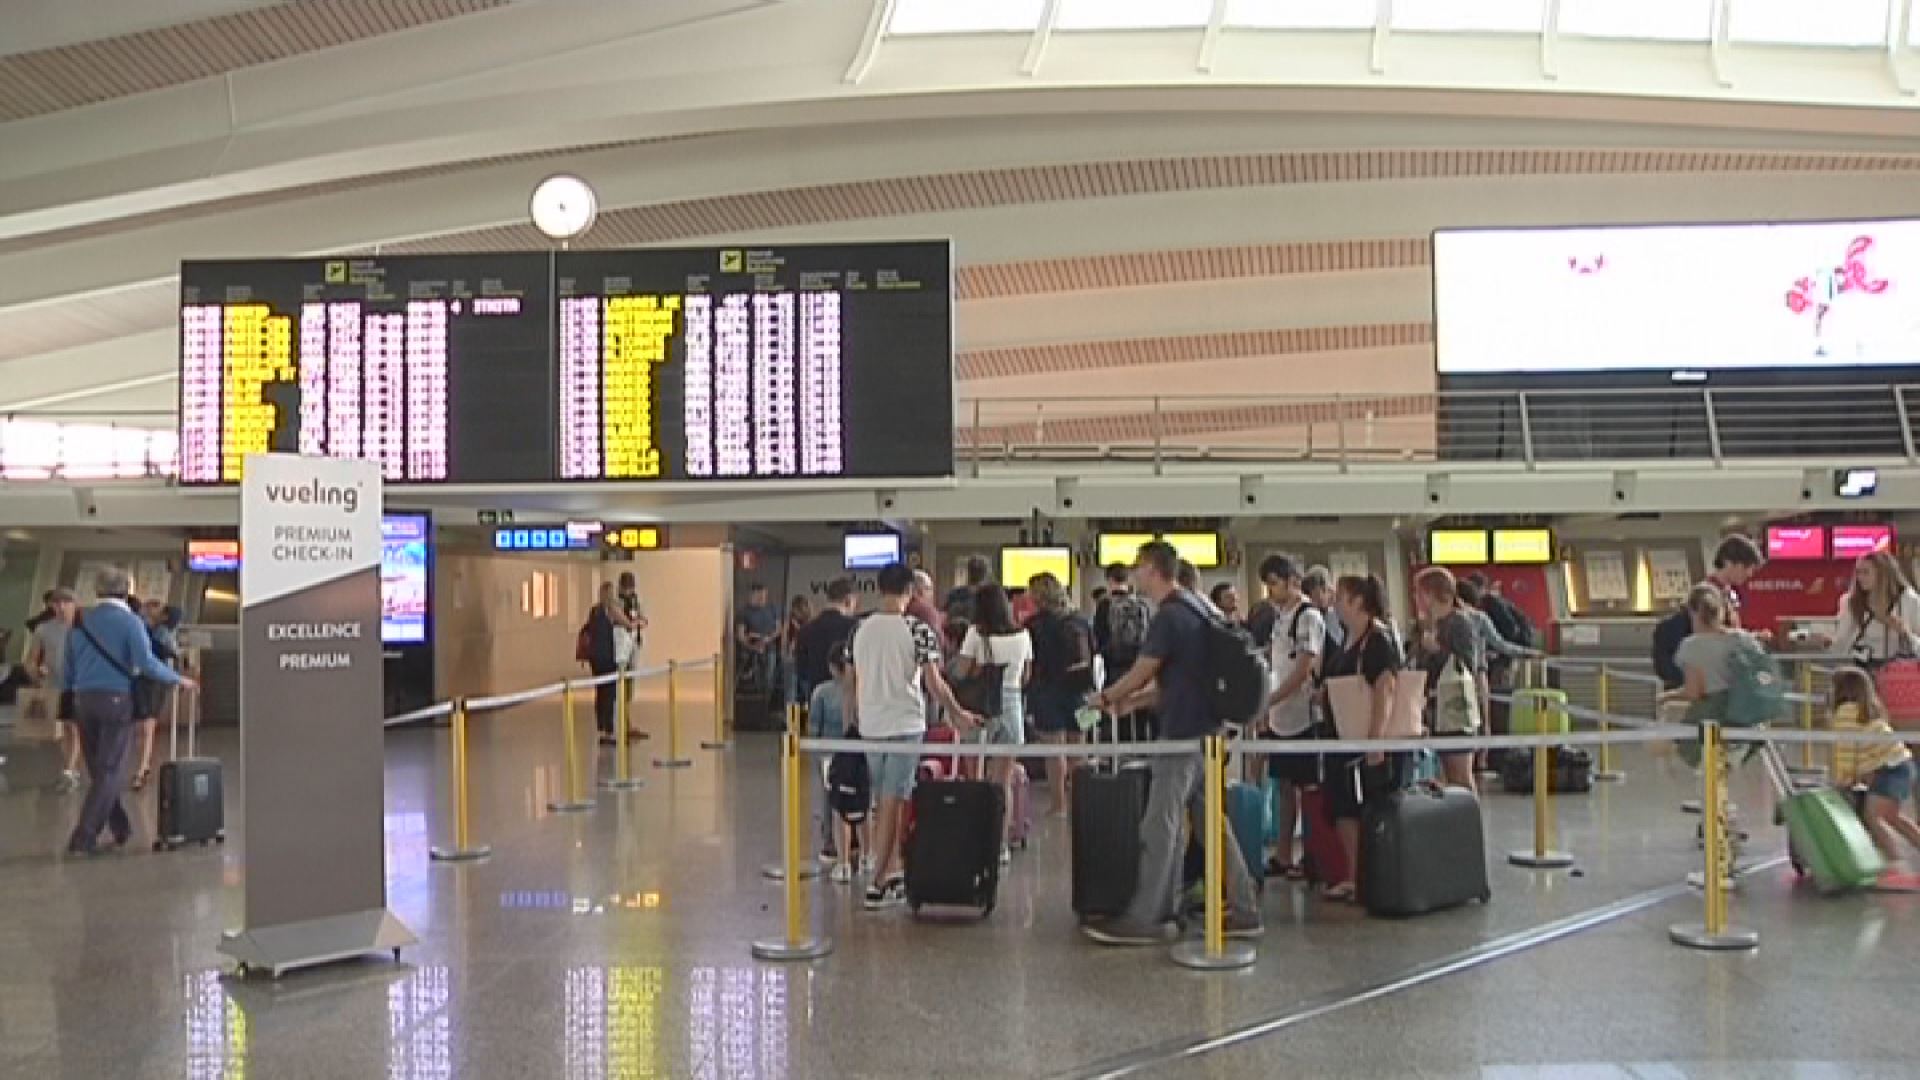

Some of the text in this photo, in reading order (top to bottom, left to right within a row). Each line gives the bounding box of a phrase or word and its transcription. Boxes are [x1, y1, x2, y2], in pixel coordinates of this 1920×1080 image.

[265, 477, 359, 513] vueling
[274, 525, 352, 542] PREMIUM
[272, 544, 353, 561] CHECK-IN
[268, 623, 361, 639] EXCELLENCE
[279, 653, 350, 669] PREMIUM
